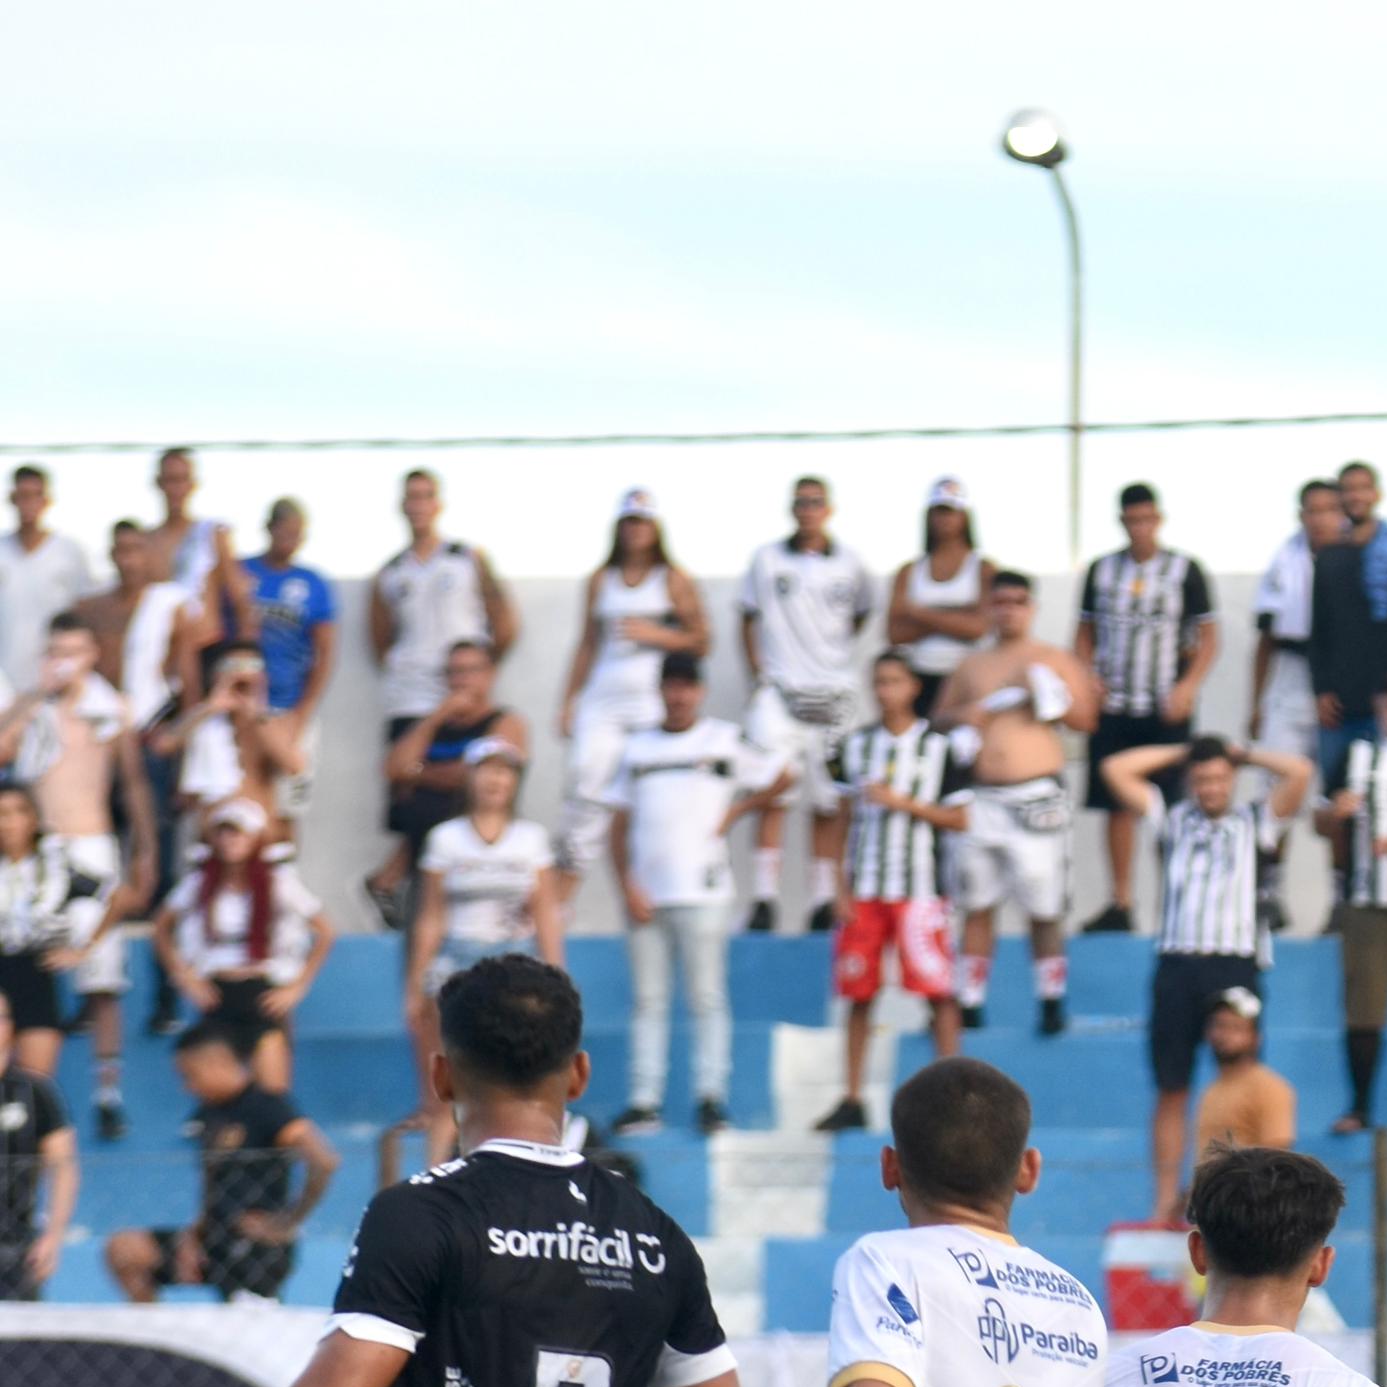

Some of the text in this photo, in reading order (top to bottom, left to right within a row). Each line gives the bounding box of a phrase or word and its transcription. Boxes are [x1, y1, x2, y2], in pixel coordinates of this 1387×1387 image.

[487, 1221, 633, 1268] sorrifácil
[996, 1268, 1030, 1288] DOS
[1180, 1365, 1292, 1386] DOS POBRES
